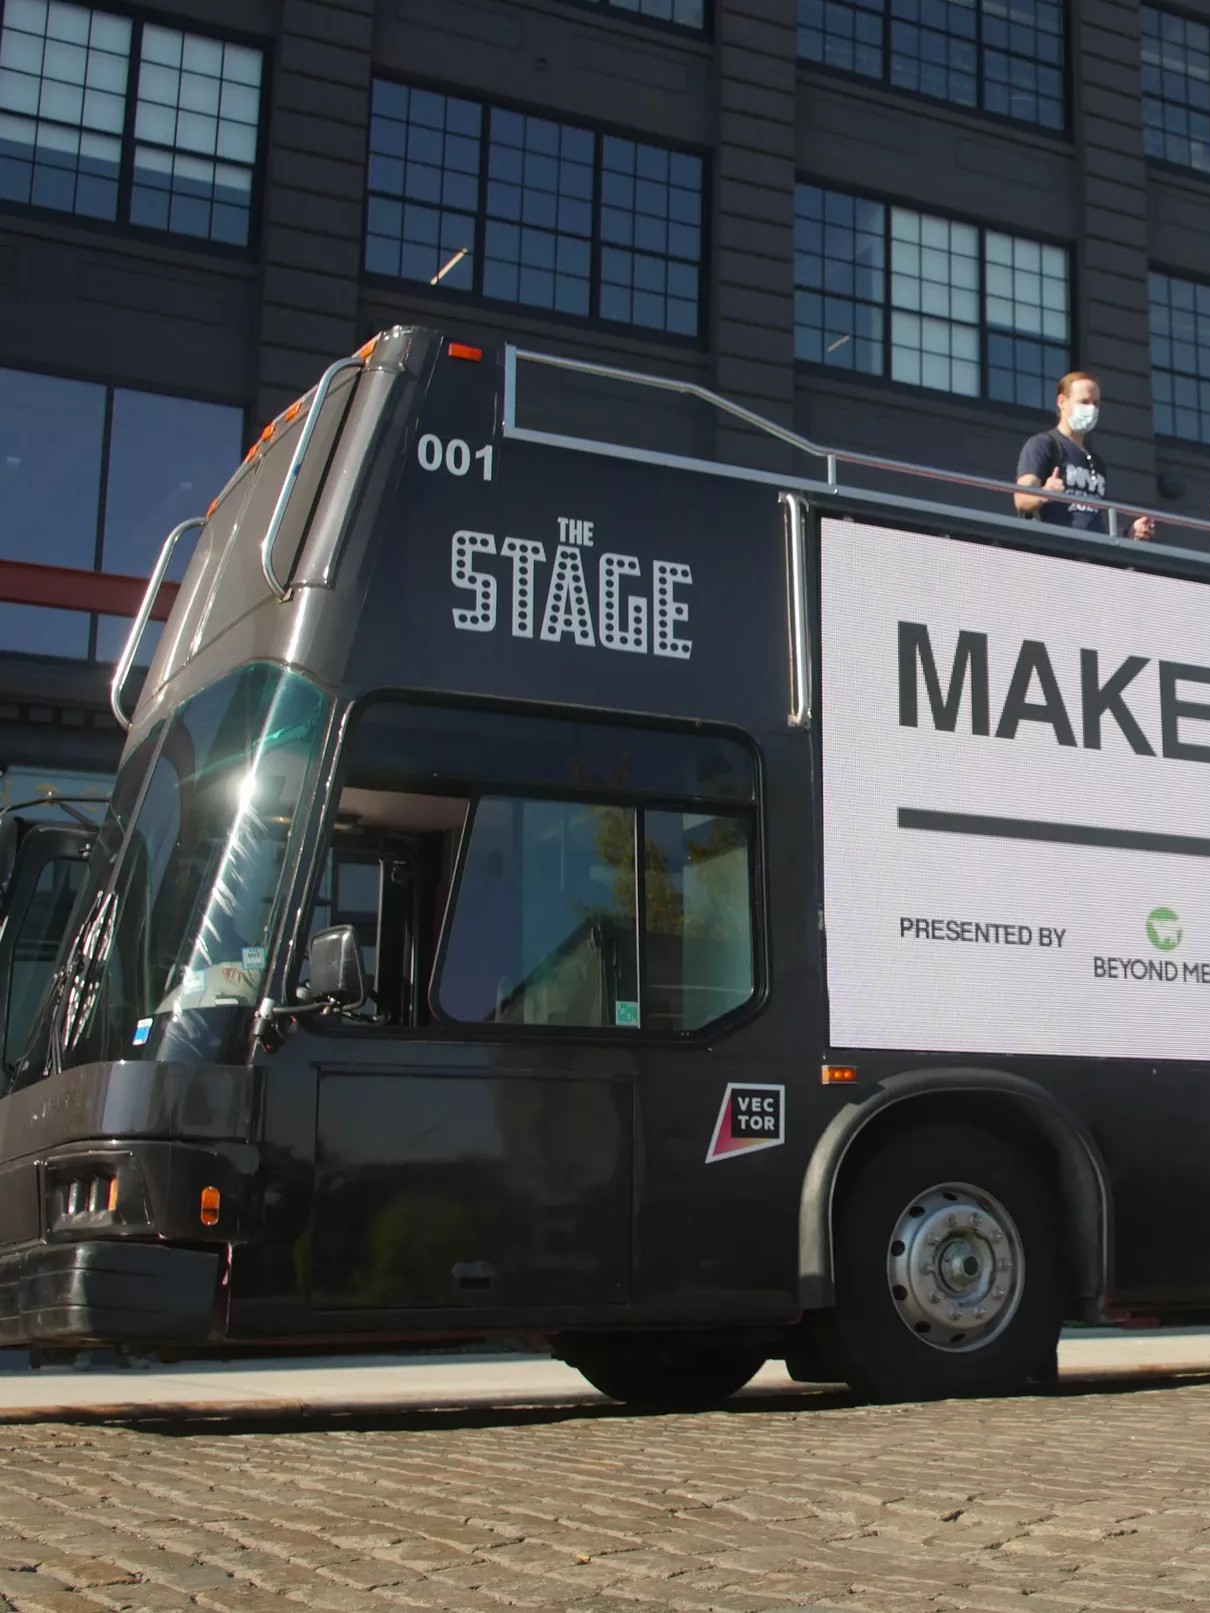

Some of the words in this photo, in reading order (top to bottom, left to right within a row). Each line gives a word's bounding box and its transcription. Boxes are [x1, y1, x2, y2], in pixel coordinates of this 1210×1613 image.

[416, 433, 493, 481] 001
[557, 517, 594, 547] THE
[451, 530, 693, 660] STAGE
[899, 917, 1033, 946] PRESENTED
[1038, 926, 1067, 948] BY
[1093, 956, 1179, 983] BEYOND
[737, 1096, 775, 1113] VEC
[737, 1115, 776, 1131] TOR
